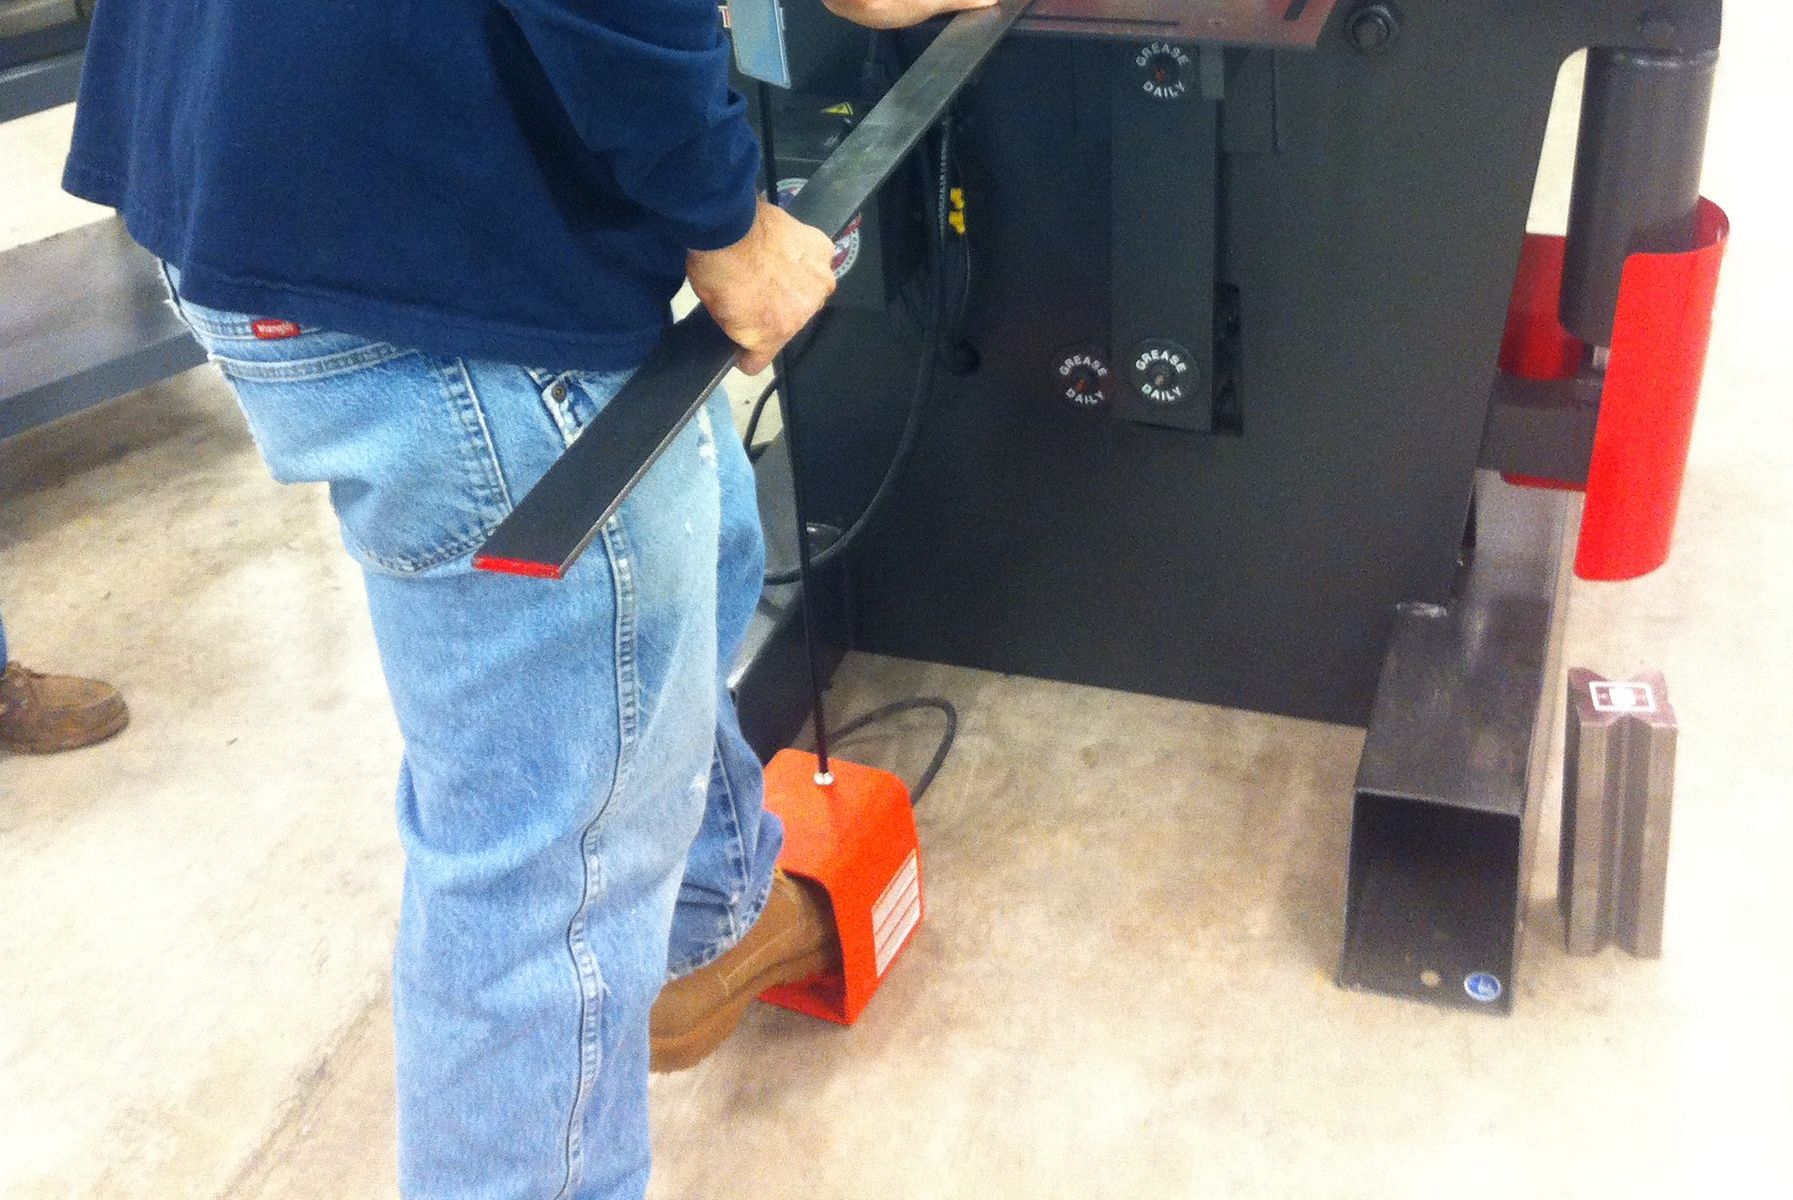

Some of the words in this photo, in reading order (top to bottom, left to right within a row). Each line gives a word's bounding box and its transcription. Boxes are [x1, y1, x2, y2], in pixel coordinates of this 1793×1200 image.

[1135, 42, 1189, 67] GREASE
[1143, 80, 1185, 98] DAILY
[1059, 355, 1107, 377] GREASE
[1135, 349, 1187, 374] GREASE
[1065, 387, 1105, 404] DAILY
[1141, 383, 1182, 402] DAILY
